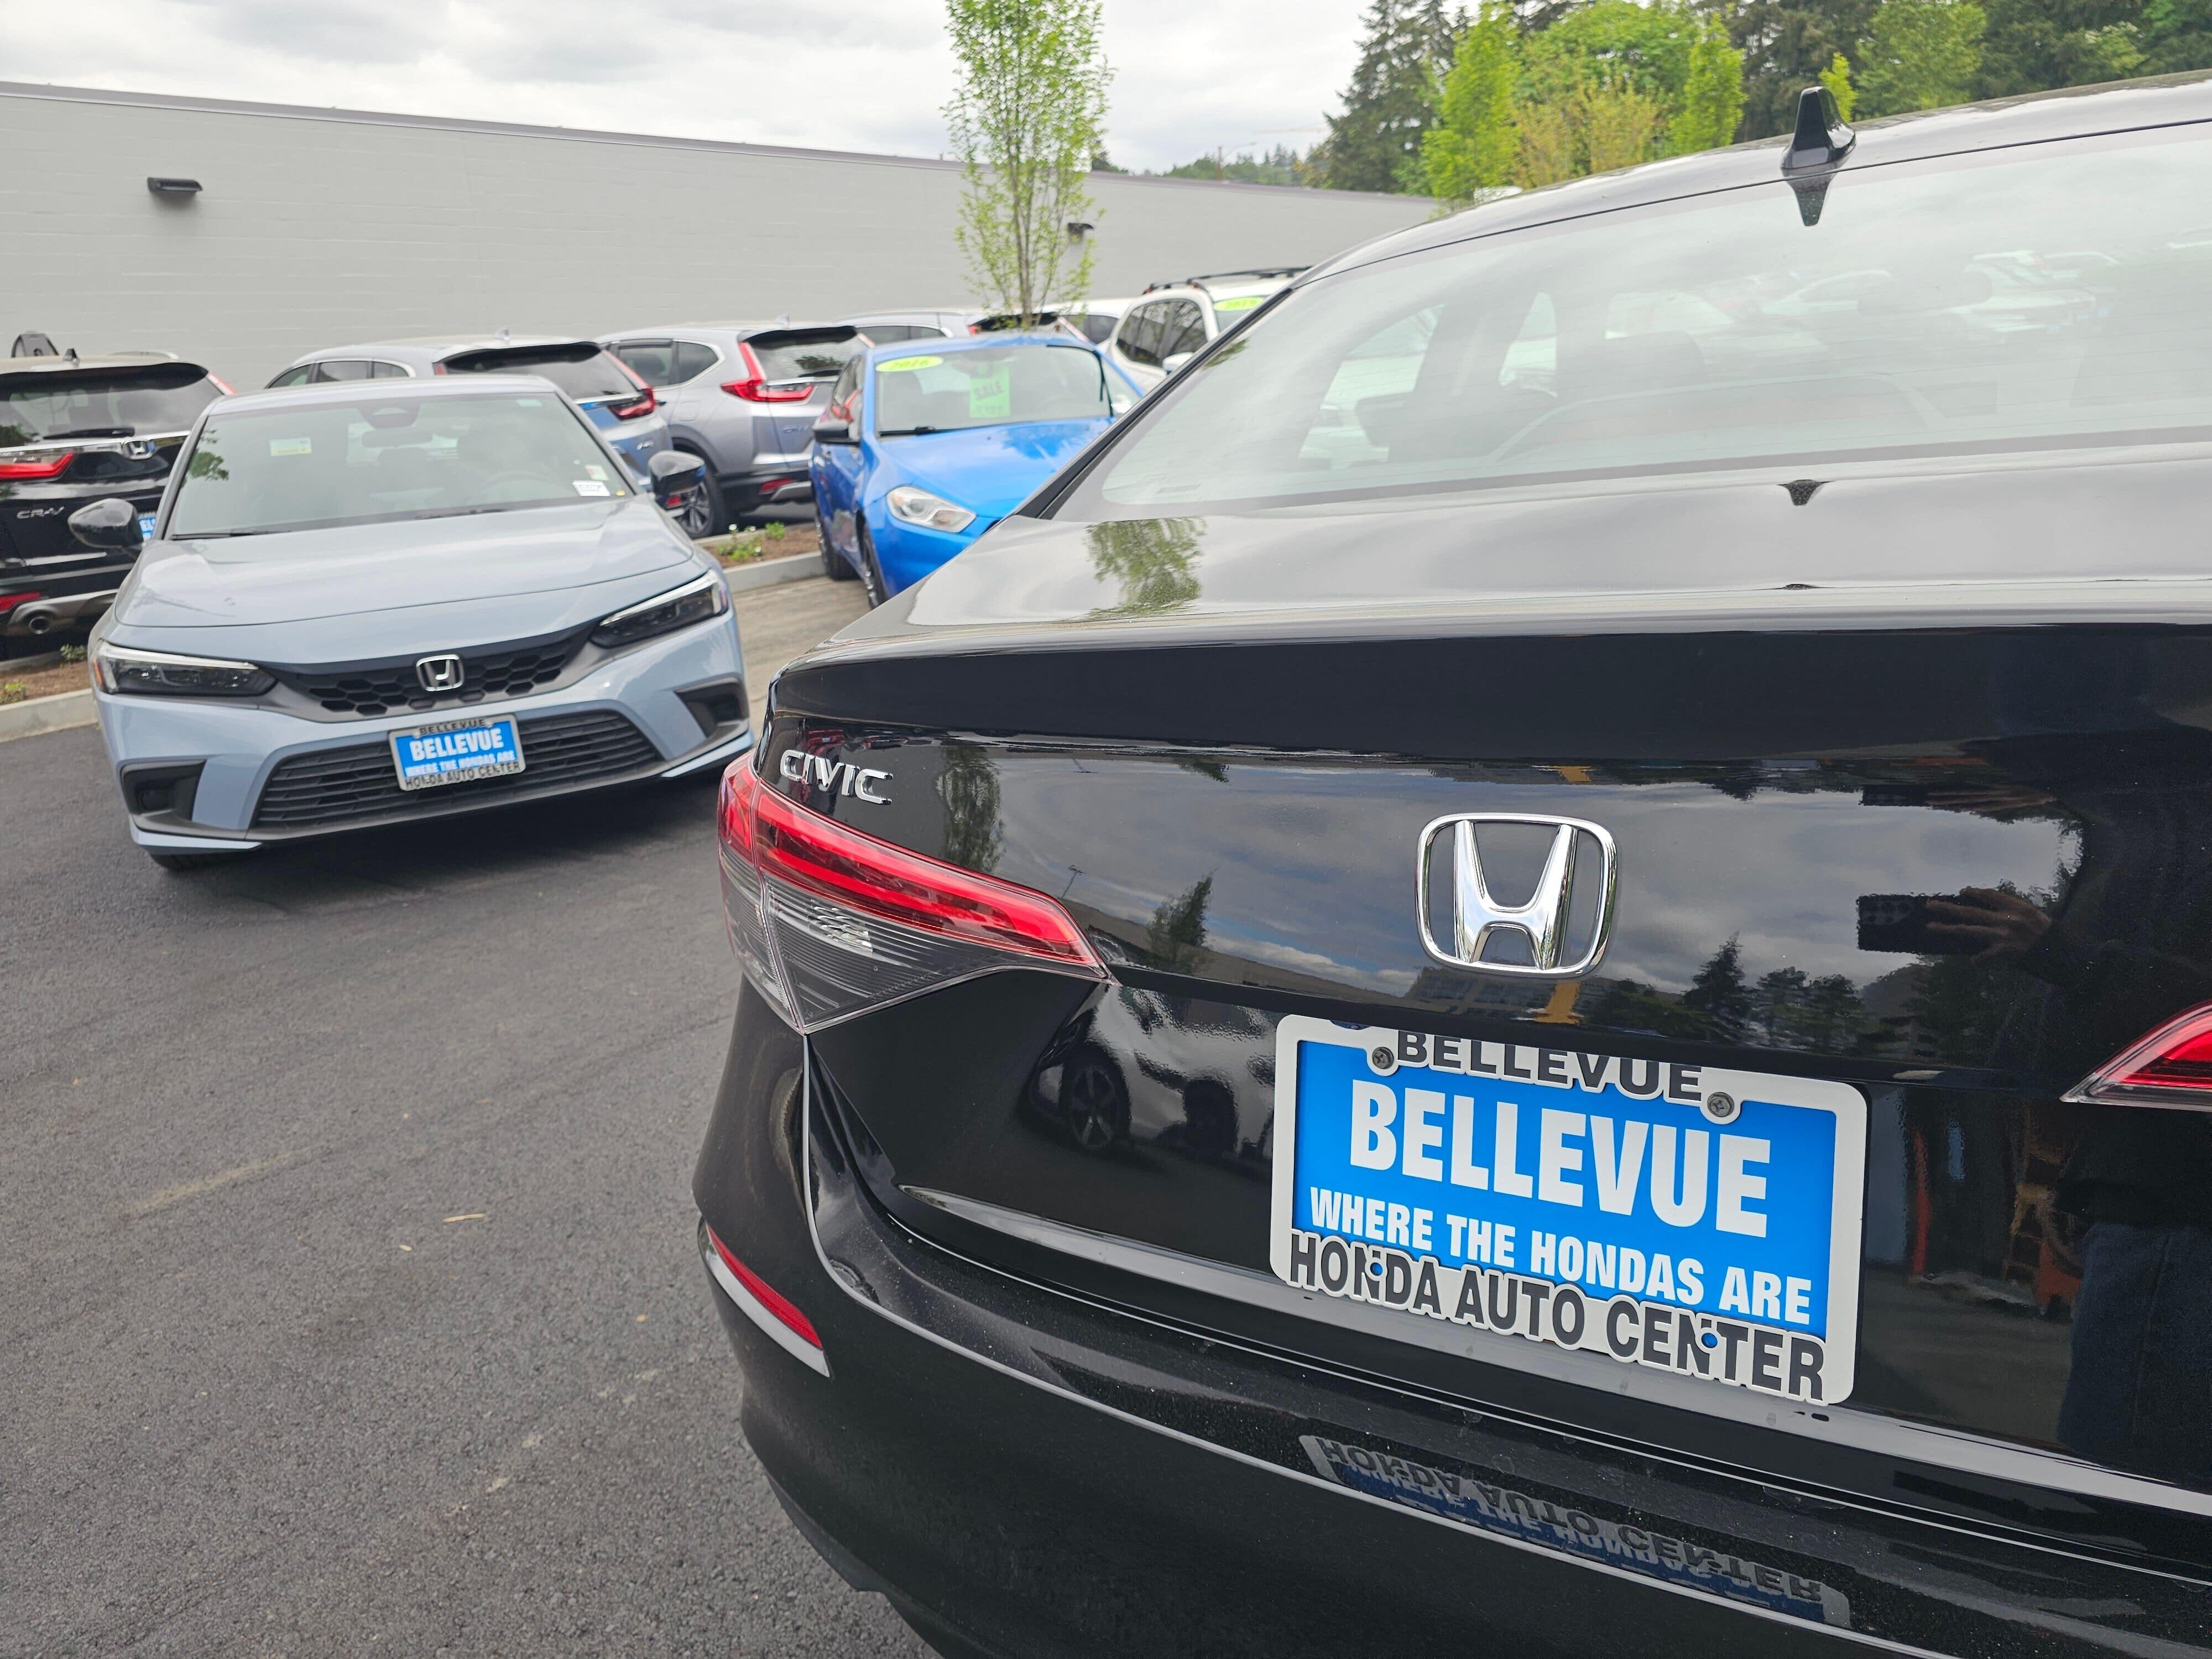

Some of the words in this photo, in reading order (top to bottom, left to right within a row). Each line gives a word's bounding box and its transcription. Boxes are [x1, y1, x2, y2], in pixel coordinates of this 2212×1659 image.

[409, 727, 504, 761] BELLEVUE
[419, 718, 487, 735] BELLEVUE
[405, 774, 444, 789] HONDA
[446, 768, 474, 784] AUTO
[478, 761, 521, 778] CENTER
[440, 760, 458, 772] THE
[497, 750, 516, 762] ARE
[780, 749, 894, 805] CIVIC
[1397, 1030, 1702, 1102] BELLEVUE
[1350, 1079, 1771, 1238] BELLEVUE
[1310, 1186, 1433, 1251] WHERE
[1446, 1213, 1516, 1269] THE
[1530, 1230, 1704, 1306] HONDAS
[1718, 1266, 1812, 1326] ARE
[1290, 1233, 1442, 1316] HONDA
[1454, 1269, 1585, 1346] AUTO
[1606, 1300, 1824, 1402] CENTER
